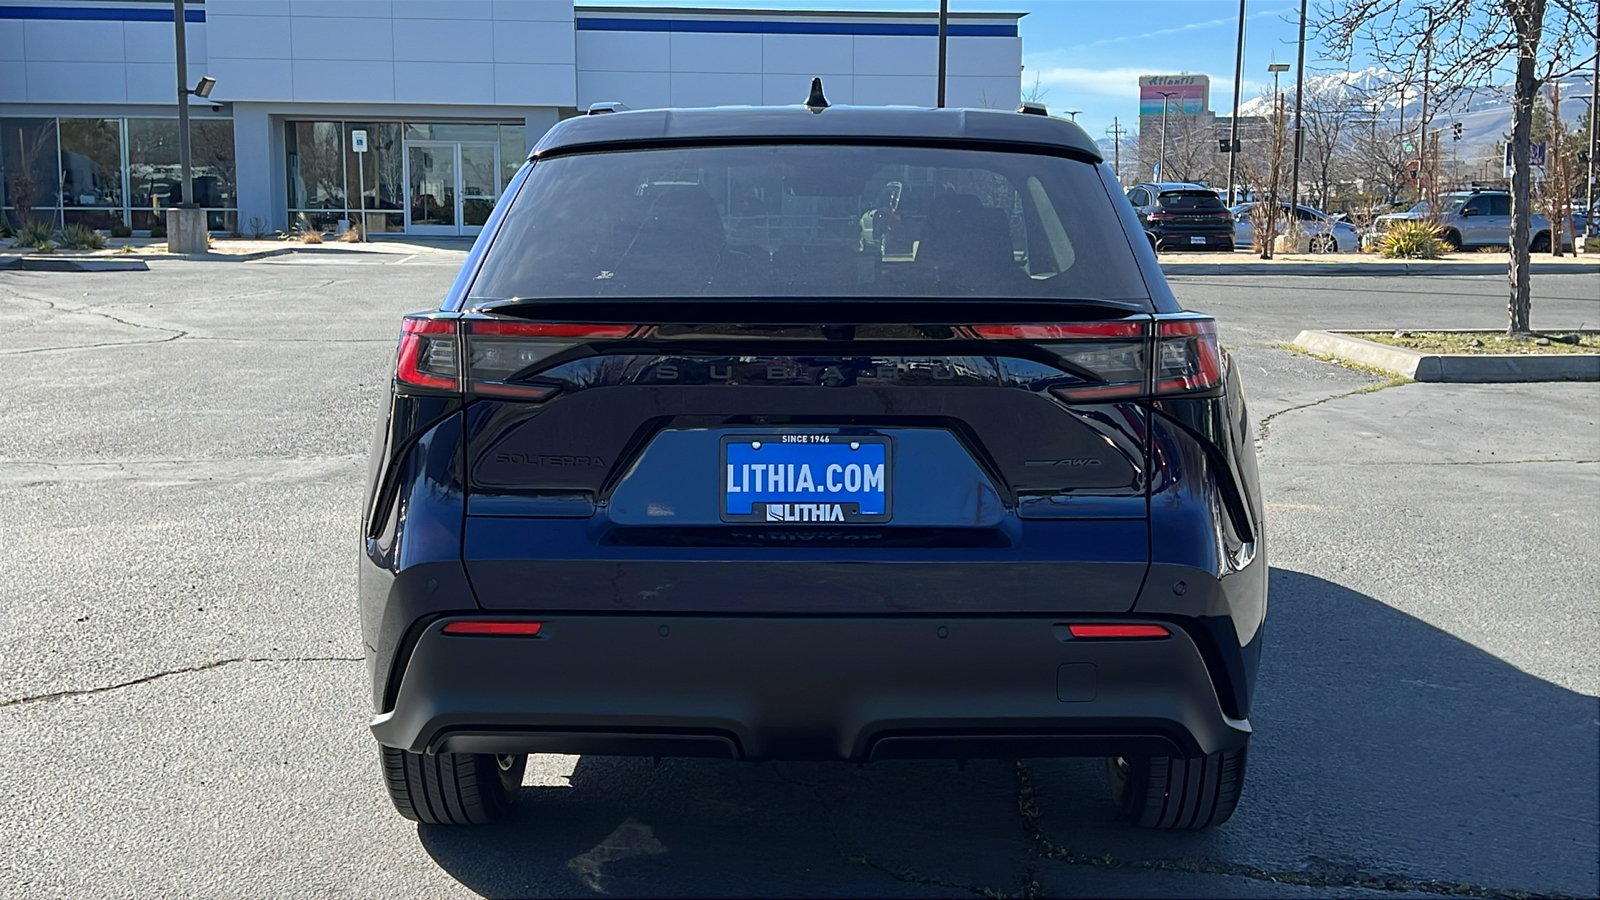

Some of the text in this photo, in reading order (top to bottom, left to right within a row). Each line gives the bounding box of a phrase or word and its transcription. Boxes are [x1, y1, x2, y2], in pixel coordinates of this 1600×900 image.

[1149, 76, 1195, 86] Atlantis
[656, 365, 955, 380] SUBARU
[782, 435, 830, 443] SINCE 1946
[496, 453, 606, 467] SOLTERRA
[1053, 458, 1103, 467] AWD
[727, 464, 885, 493] LITHIA.COM
[784, 504, 845, 522] LITHIA
